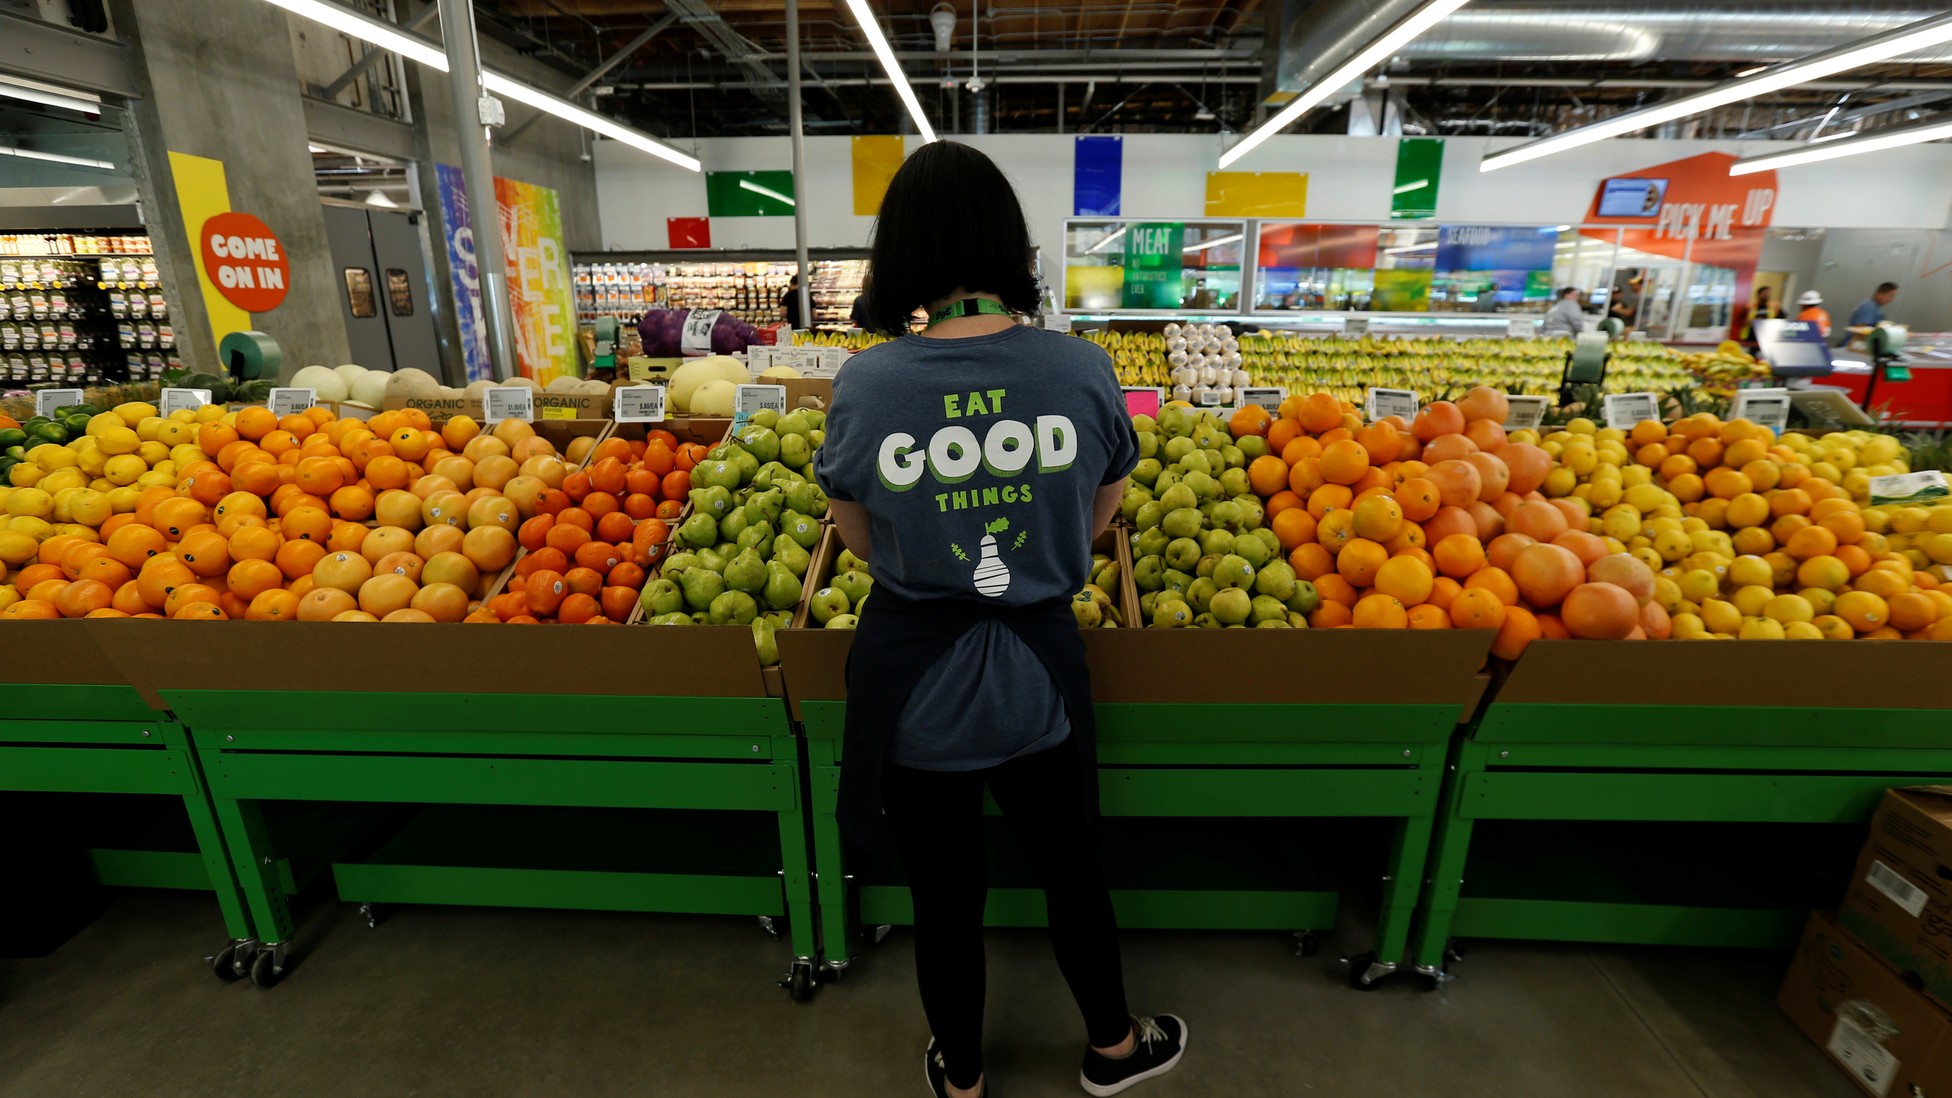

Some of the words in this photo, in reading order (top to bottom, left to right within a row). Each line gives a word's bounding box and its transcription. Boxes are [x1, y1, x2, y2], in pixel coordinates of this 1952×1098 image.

[1655, 203, 1705, 240] PICK
[1705, 204, 1739, 241] ME
[1742, 188, 1774, 226] UP
[210, 233, 280, 261] COME
[1132, 227, 1172, 255] MEAT
[1447, 226, 1491, 245] SEAFOOD
[218, 264, 255, 289] ON
[256, 266, 285, 290] IN
[406, 398, 465, 409] ORGANIC
[533, 397, 591, 409] ORGANIC
[943, 388, 1006, 419] EAT
[876, 414, 1078, 493] GOOD
[935, 484, 1033, 513] THINGS
